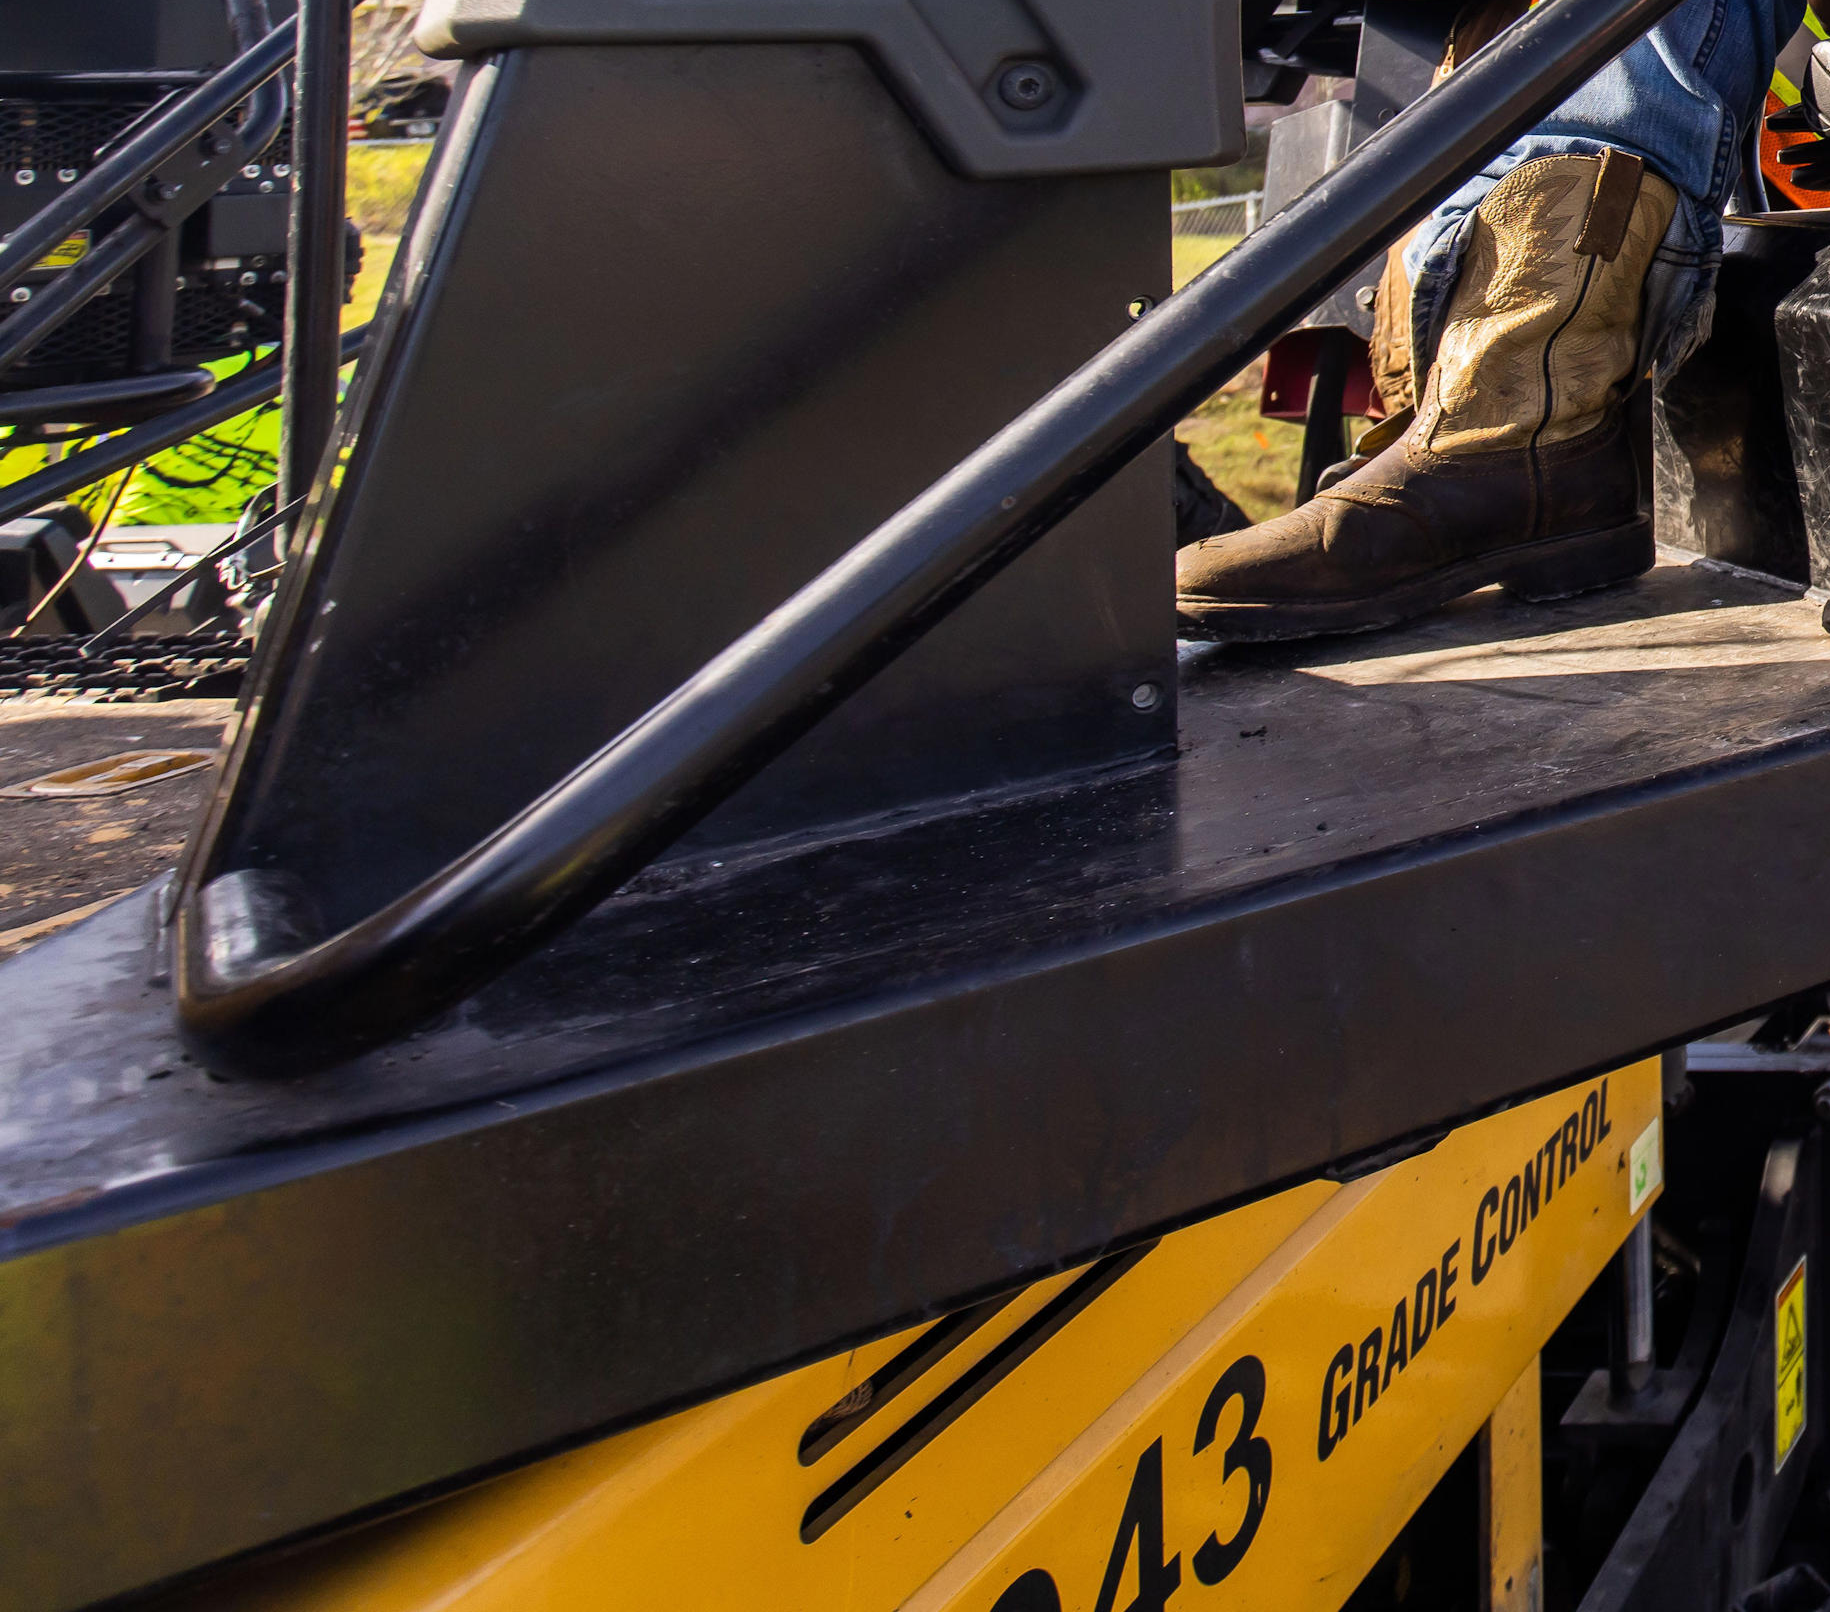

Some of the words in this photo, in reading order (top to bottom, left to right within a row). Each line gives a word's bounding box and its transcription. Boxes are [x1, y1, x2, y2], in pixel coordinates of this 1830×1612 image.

[989, 1354, 1273, 1612] 43
[1317, 1237, 1461, 1463] GRADE
[1471, 1077, 1613, 1287] CONTROL
